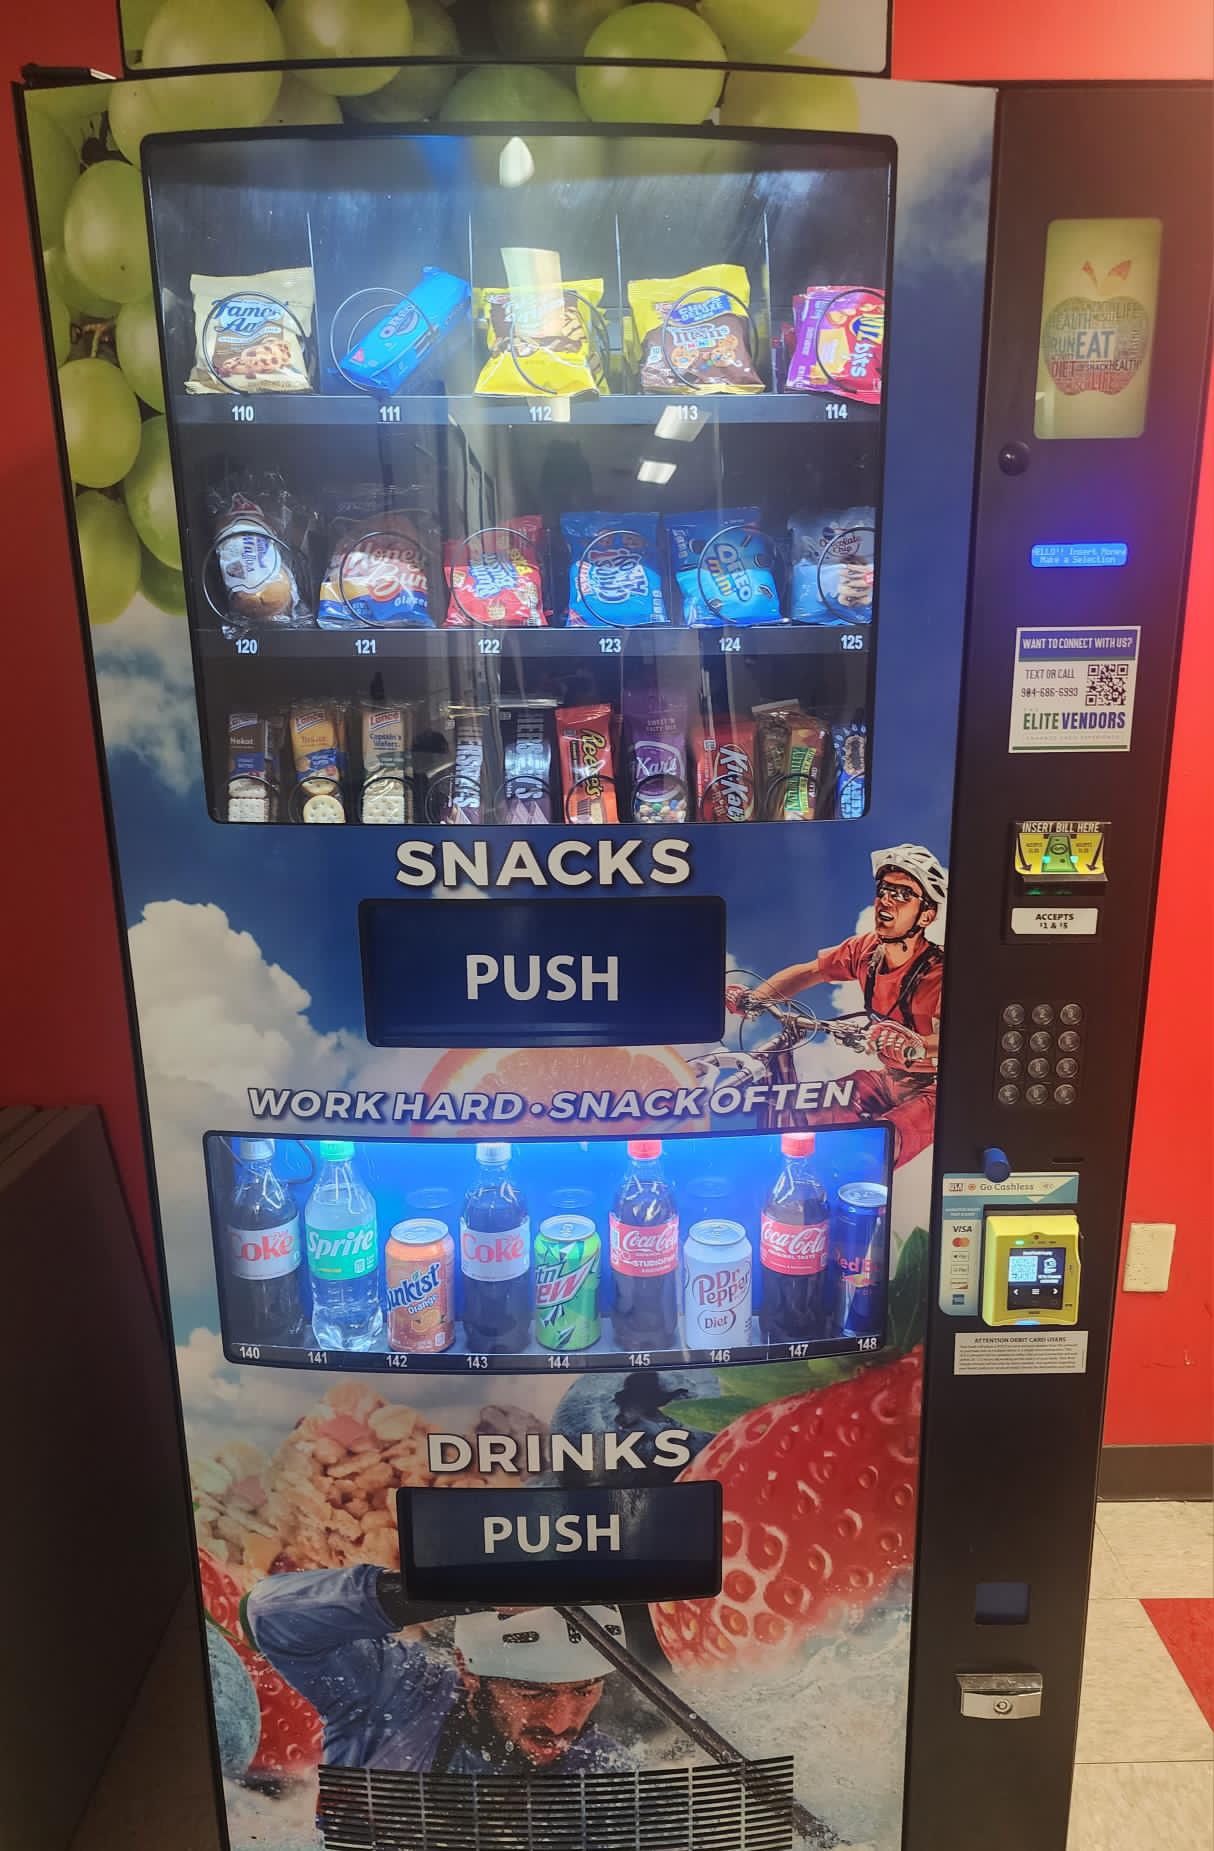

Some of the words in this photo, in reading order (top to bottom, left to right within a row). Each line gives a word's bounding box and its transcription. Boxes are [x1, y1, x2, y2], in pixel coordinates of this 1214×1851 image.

[1076, 330, 1115, 359] EAT
[232, 405, 254, 421] 110
[379, 405, 401, 421] 111
[530, 406, 552, 421] 112
[676, 405, 698, 420] 113
[826, 404, 848, 419] 114
[1072, 555, 1116, 564] Selection
[368, 561, 429, 597] Bun
[706, 558, 736, 597] mini
[715, 543, 752, 602] OREO
[235, 639, 258, 654] 120
[355, 639, 376, 654] 121
[478, 639, 500, 654] 122
[599, 638, 621, 653] 123
[719, 637, 741, 652] 124
[841, 635, 863, 650] 125
[1022, 638, 1047, 649] WANT
[1048, 638, 1058, 649] TO
[1059, 638, 1093, 649] CONNECT
[1094, 637, 1115, 648] WITH
[1116, 637, 1133, 648] US?
[1025, 669, 1045, 680] TEXT
[1046, 669, 1057, 679] OR
[1058, 668, 1075, 679] CALL
[370, 711, 400, 725] Lance
[1023, 712, 1059, 730] ELITE
[1062, 711, 1126, 729] VENDORS
[580, 728, 606, 798] Reee's
[808, 766, 818, 798] ALMND
[1022, 822, 1053, 833] INSERT
[1055, 822, 1075, 833] BILL
[1077, 822, 1099, 833] HERE
[396, 839, 691, 887] SNACKS
[1035, 913, 1075, 921] ACCEPTS
[466, 954, 619, 1001] PUSH
[248, 1087, 387, 1121] WORK
[392, 1091, 525, 1122] HARD
[547, 1086, 706, 1119] SNACK
[708, 1080, 856, 1114] OFTEN
[980, 1183, 992, 1191] Go
[995, 1183, 1034, 1191] Cashless
[953, 1225, 973, 1233] VISA
[309, 1229, 374, 1260] Sprite
[463, 1233, 524, 1263] Coke
[536, 1262, 560, 1285] tn
[716, 1268, 741, 1287] Dr
[387, 1262, 441, 1312] unkist
[698, 1271, 750, 1307] Pepper
[705, 1315, 729, 1329] Diet
[789, 1344, 808, 1357] 147
[858, 1338, 877, 1350] 148
[240, 1347, 260, 1360] 140
[308, 1351, 327, 1363] 141
[386, 1355, 408, 1367] 142
[629, 1354, 650, 1366] 145
[710, 1350, 730, 1362] 146
[467, 1357, 488, 1369] 143
[548, 1356, 569, 1368] 144
[427, 1429, 690, 1473] DRINKS
[483, 1514, 621, 1554] PUSH
